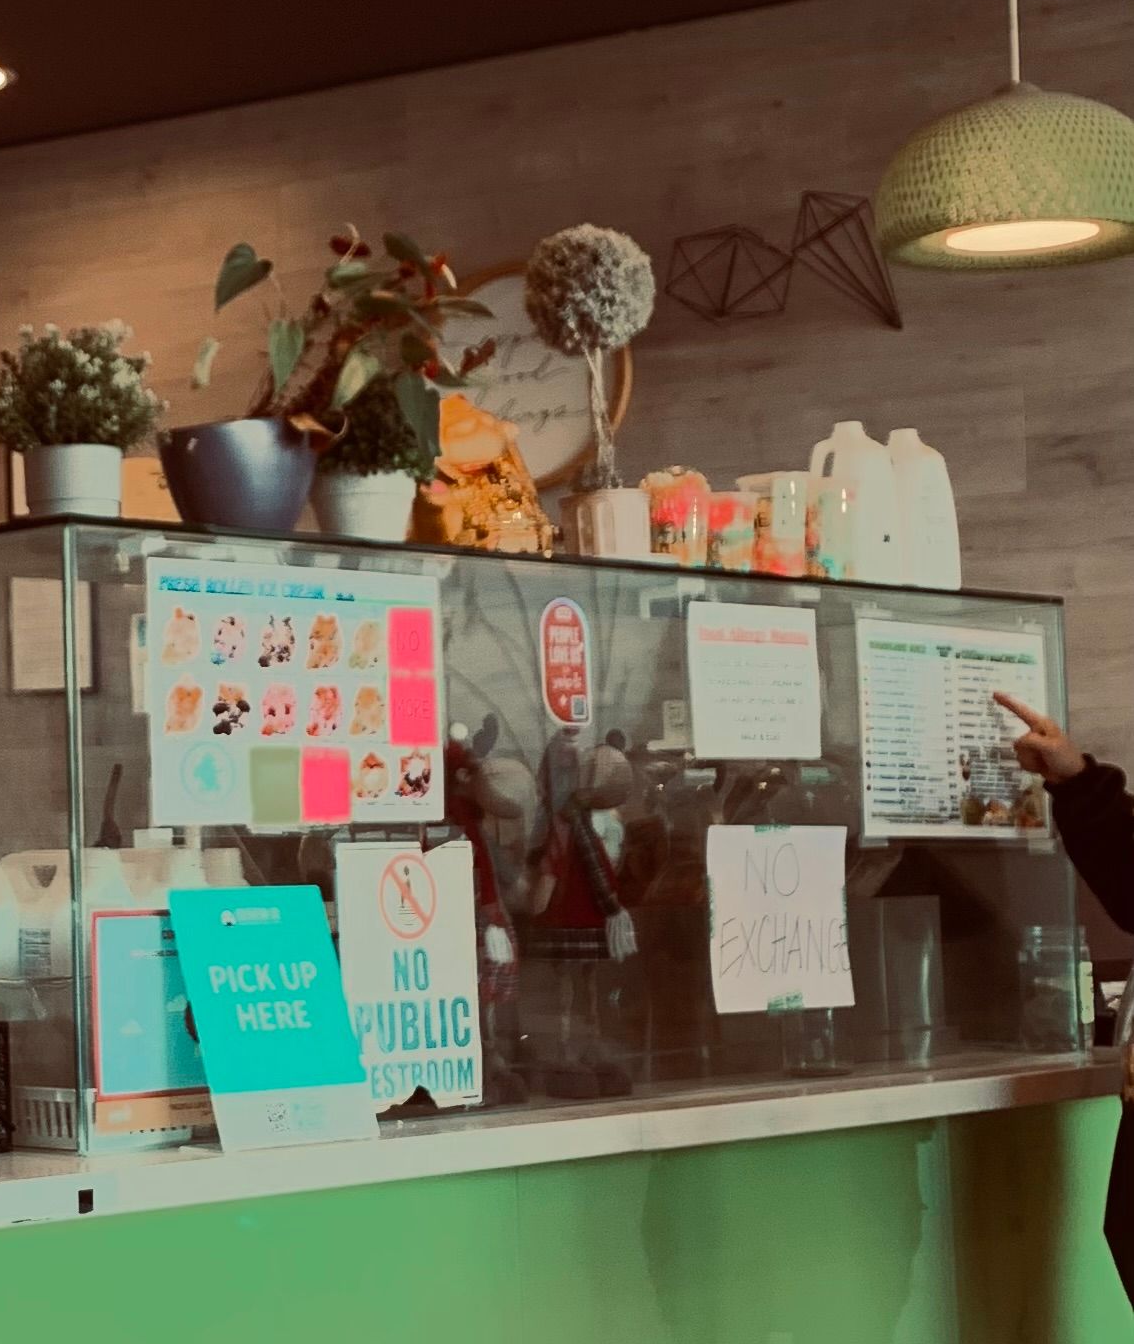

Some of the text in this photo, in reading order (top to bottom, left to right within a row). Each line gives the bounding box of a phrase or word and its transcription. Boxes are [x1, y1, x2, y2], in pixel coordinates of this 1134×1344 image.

[391, 698, 431, 719] MORE
[745, 843, 800, 896] NO
[720, 912, 850, 978] EXCHANGE
[208, 960, 318, 994] PICK UP
[392, 947, 430, 992] NO
[235, 999, 312, 1032] HERE
[353, 996, 472, 1055] PUBLIC
[370, 1057, 475, 1099] ESTROOM
